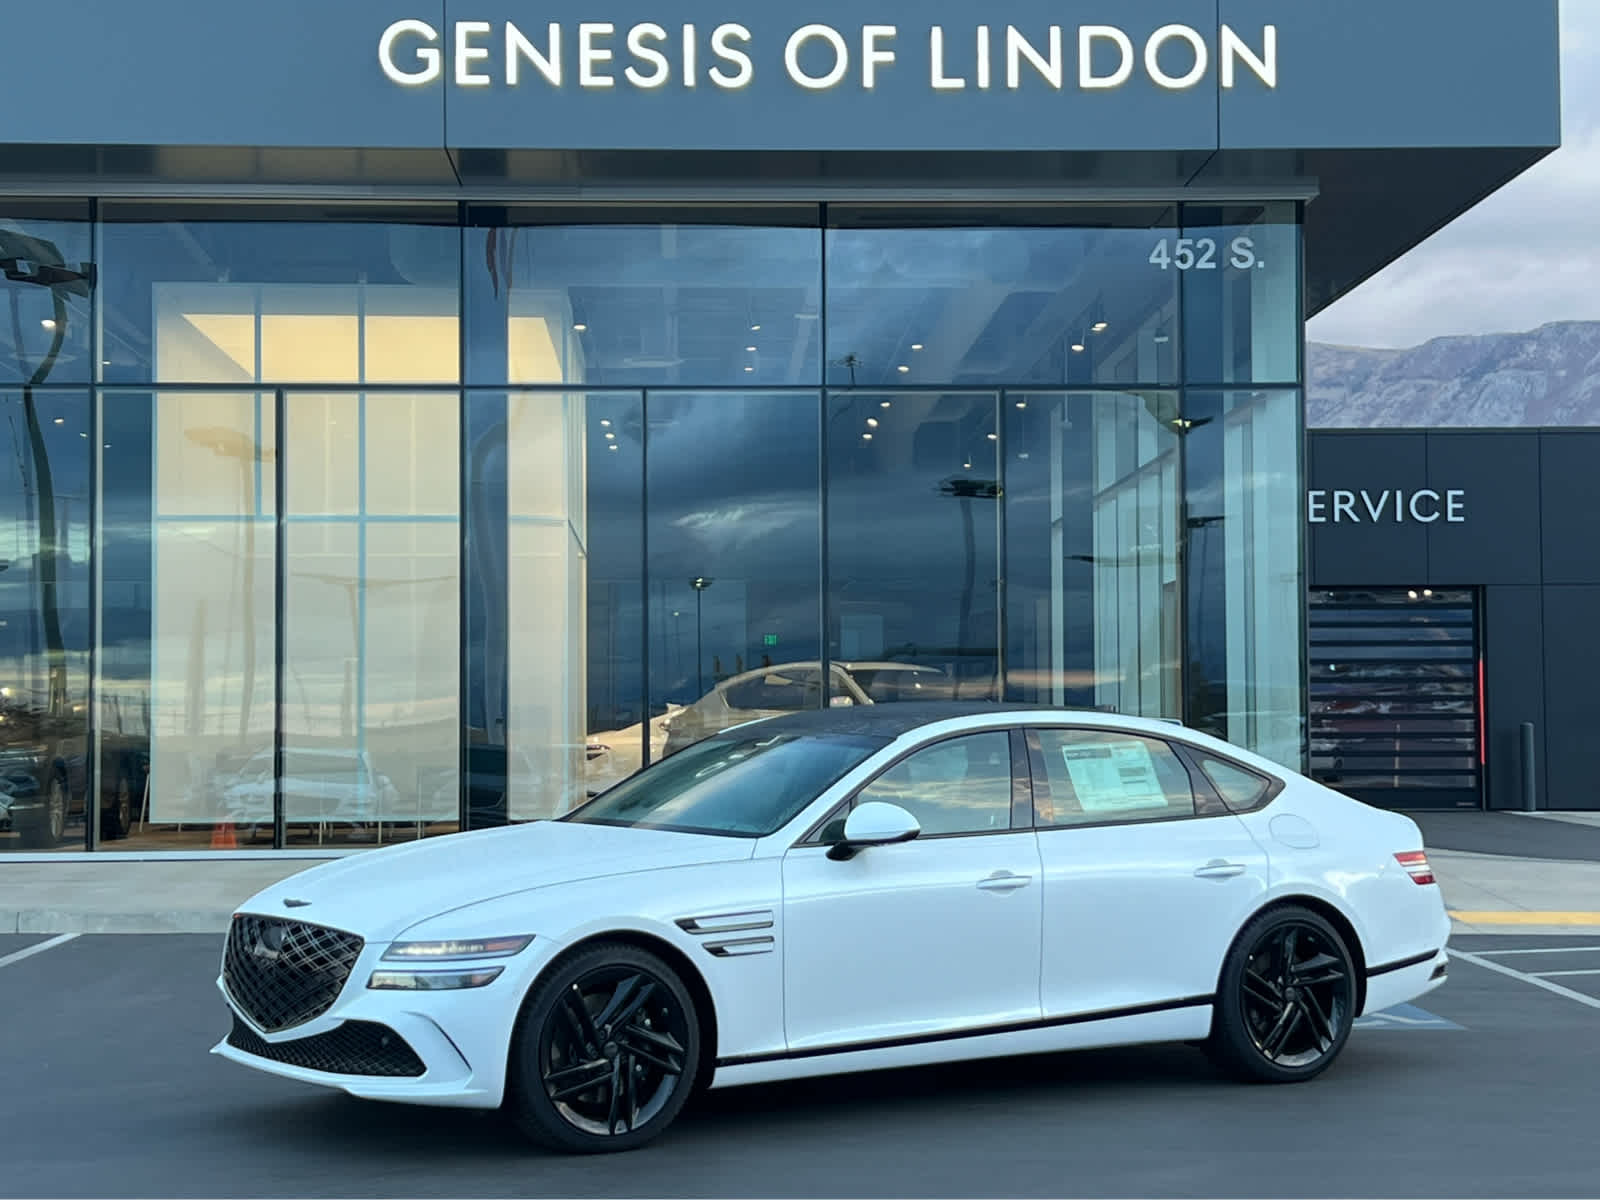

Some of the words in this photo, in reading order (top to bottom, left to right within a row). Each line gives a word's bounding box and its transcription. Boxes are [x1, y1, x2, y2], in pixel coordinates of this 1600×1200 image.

[378, 19, 753, 88] GENESIS
[784, 23, 897, 89] OF
[930, 24, 1277, 89] LINDON
[1149, 238, 1216, 270] 452
[1230, 236, 1265, 269] S.
[1308, 489, 1465, 523] ERVICE
